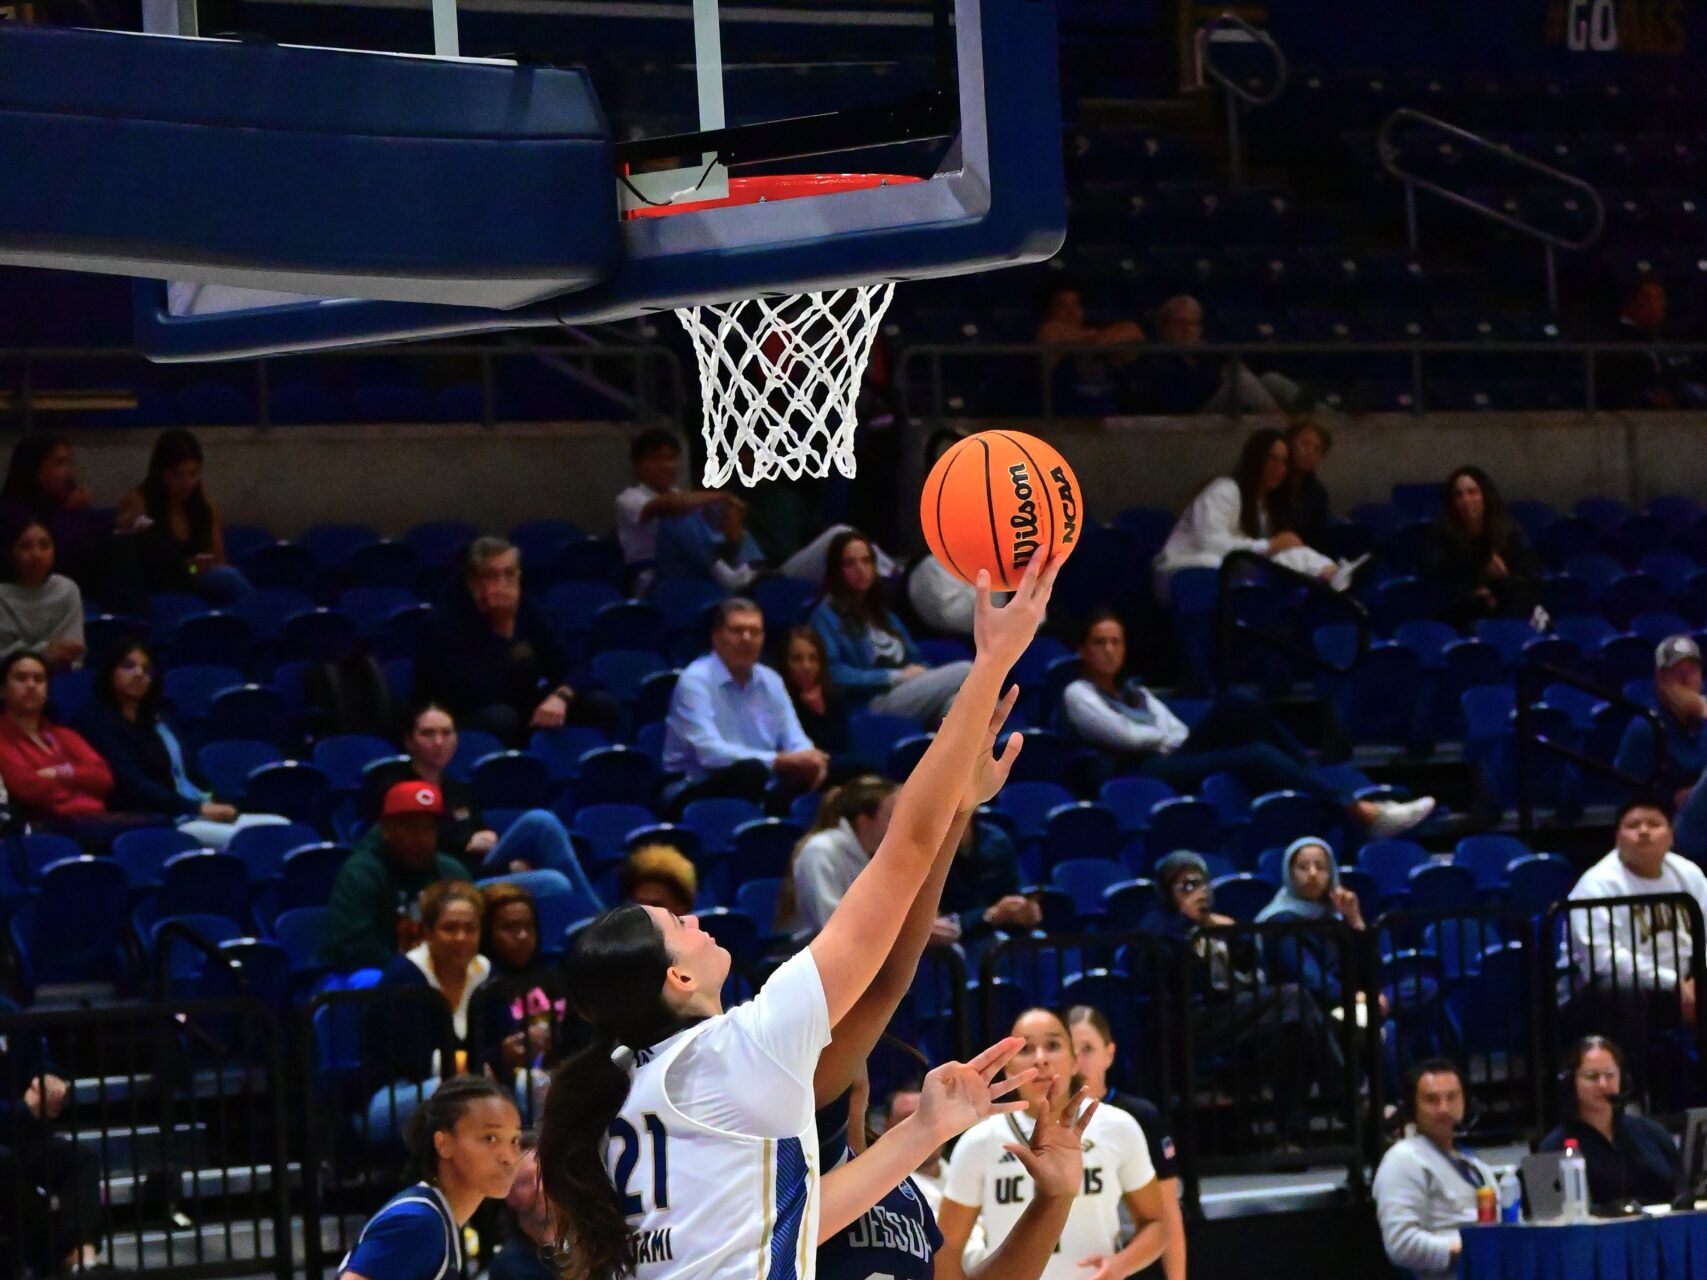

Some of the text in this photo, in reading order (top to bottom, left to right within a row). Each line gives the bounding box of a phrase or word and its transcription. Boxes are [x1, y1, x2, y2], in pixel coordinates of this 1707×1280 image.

[1008, 462, 1039, 569] Wilson
[1050, 466, 1076, 544] NCAA
[605, 1111, 669, 1217] 21
